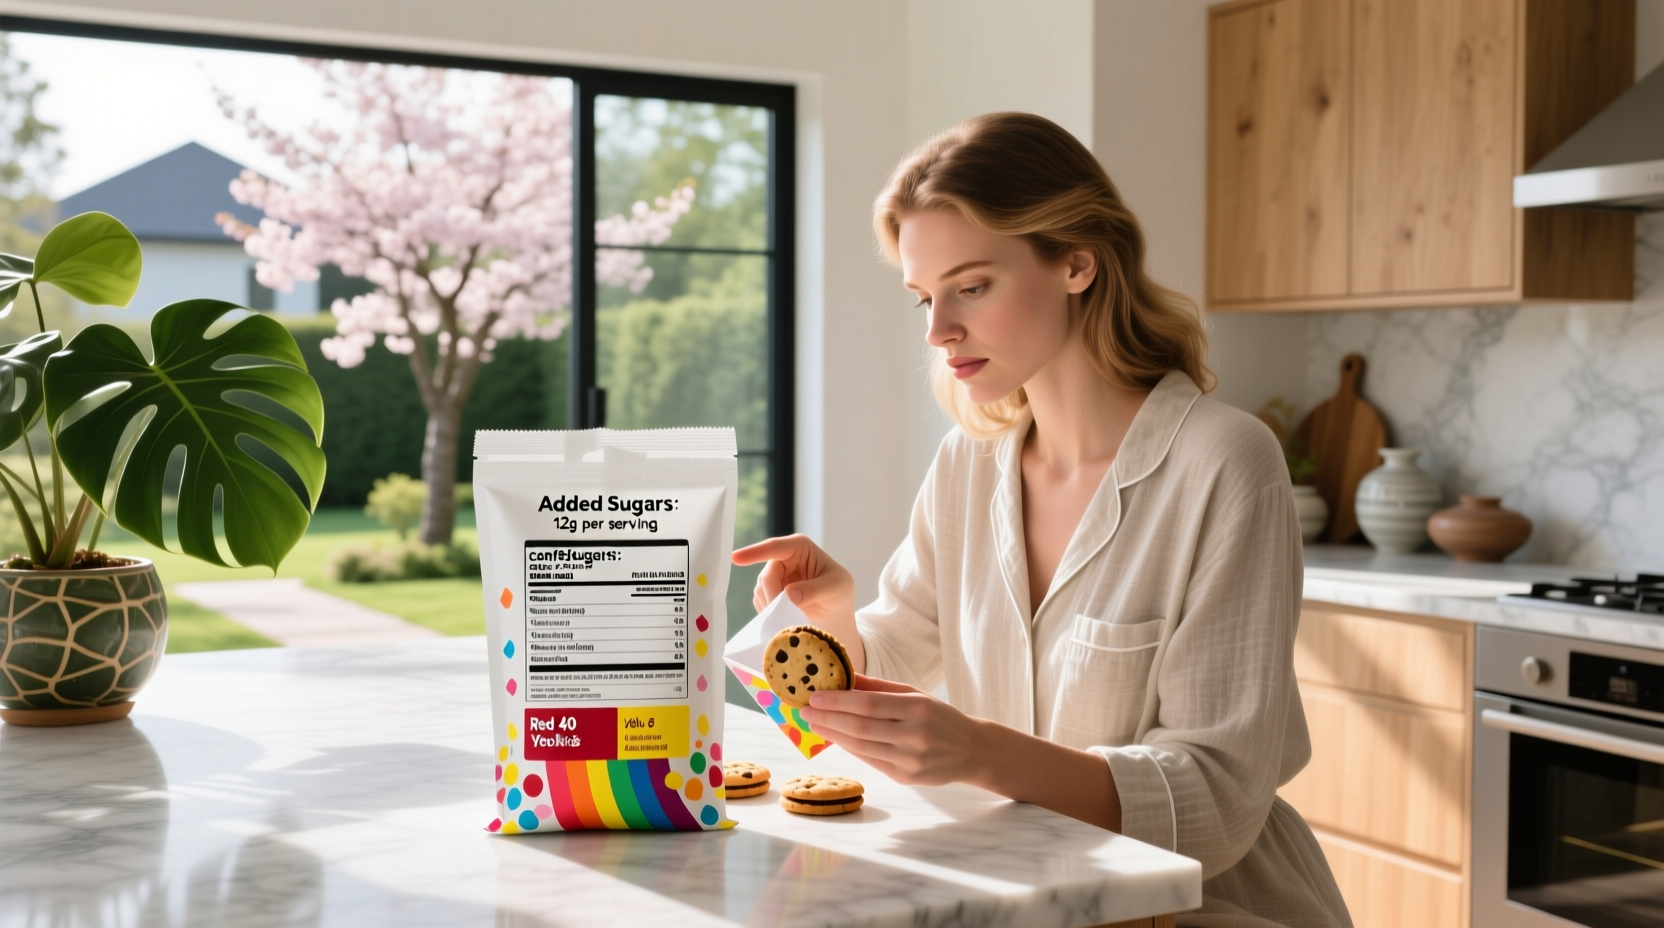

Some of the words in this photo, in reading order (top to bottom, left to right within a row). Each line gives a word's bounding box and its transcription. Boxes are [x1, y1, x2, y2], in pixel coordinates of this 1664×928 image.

[538, 495, 602, 512] Added
[607, 495, 679, 517] Sugars:
[553, 516, 577, 533] 12g
[582, 519, 604, 533] per
[608, 518, 658, 532] serving
[530, 716, 554, 731] Red
[558, 716, 577, 731] 40
